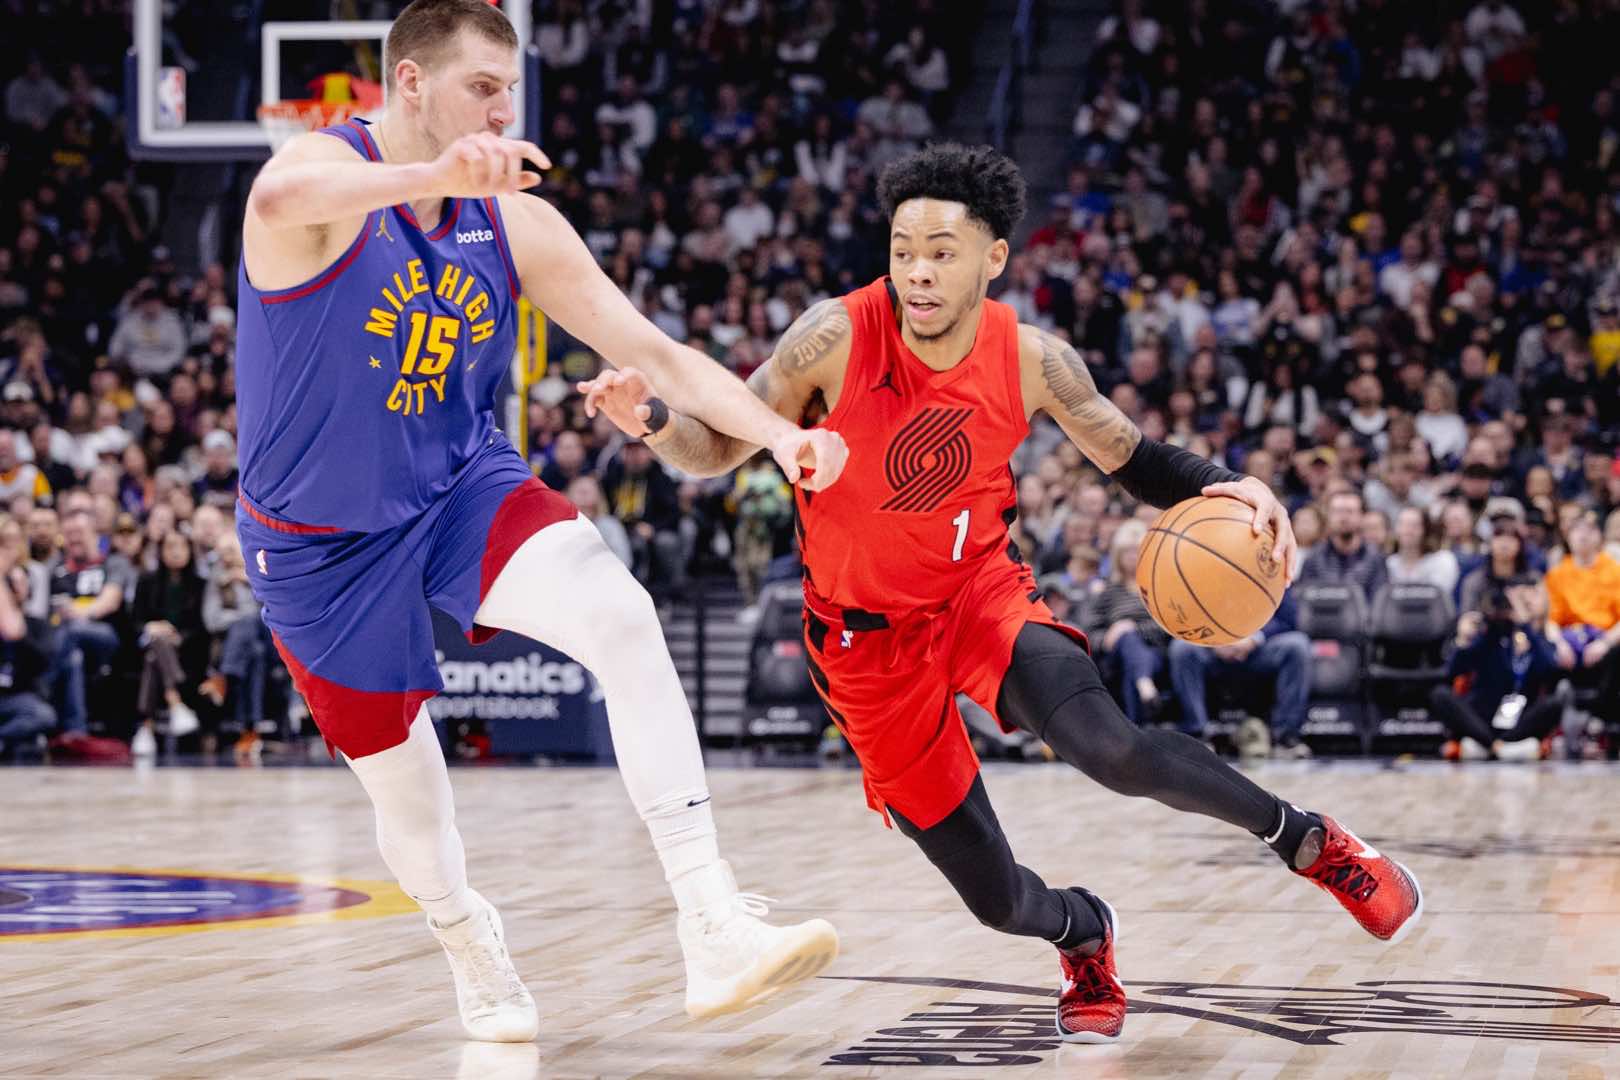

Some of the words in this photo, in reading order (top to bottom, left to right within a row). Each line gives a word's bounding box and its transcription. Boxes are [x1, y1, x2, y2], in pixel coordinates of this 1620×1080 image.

[364, 258, 429, 337] MILE
[436, 263, 495, 344] HIGH
[400, 311, 460, 376] 15
[386, 373, 447, 416] CITY
[952, 508, 971, 562] 1
[428, 694, 561, 721] portsbook
